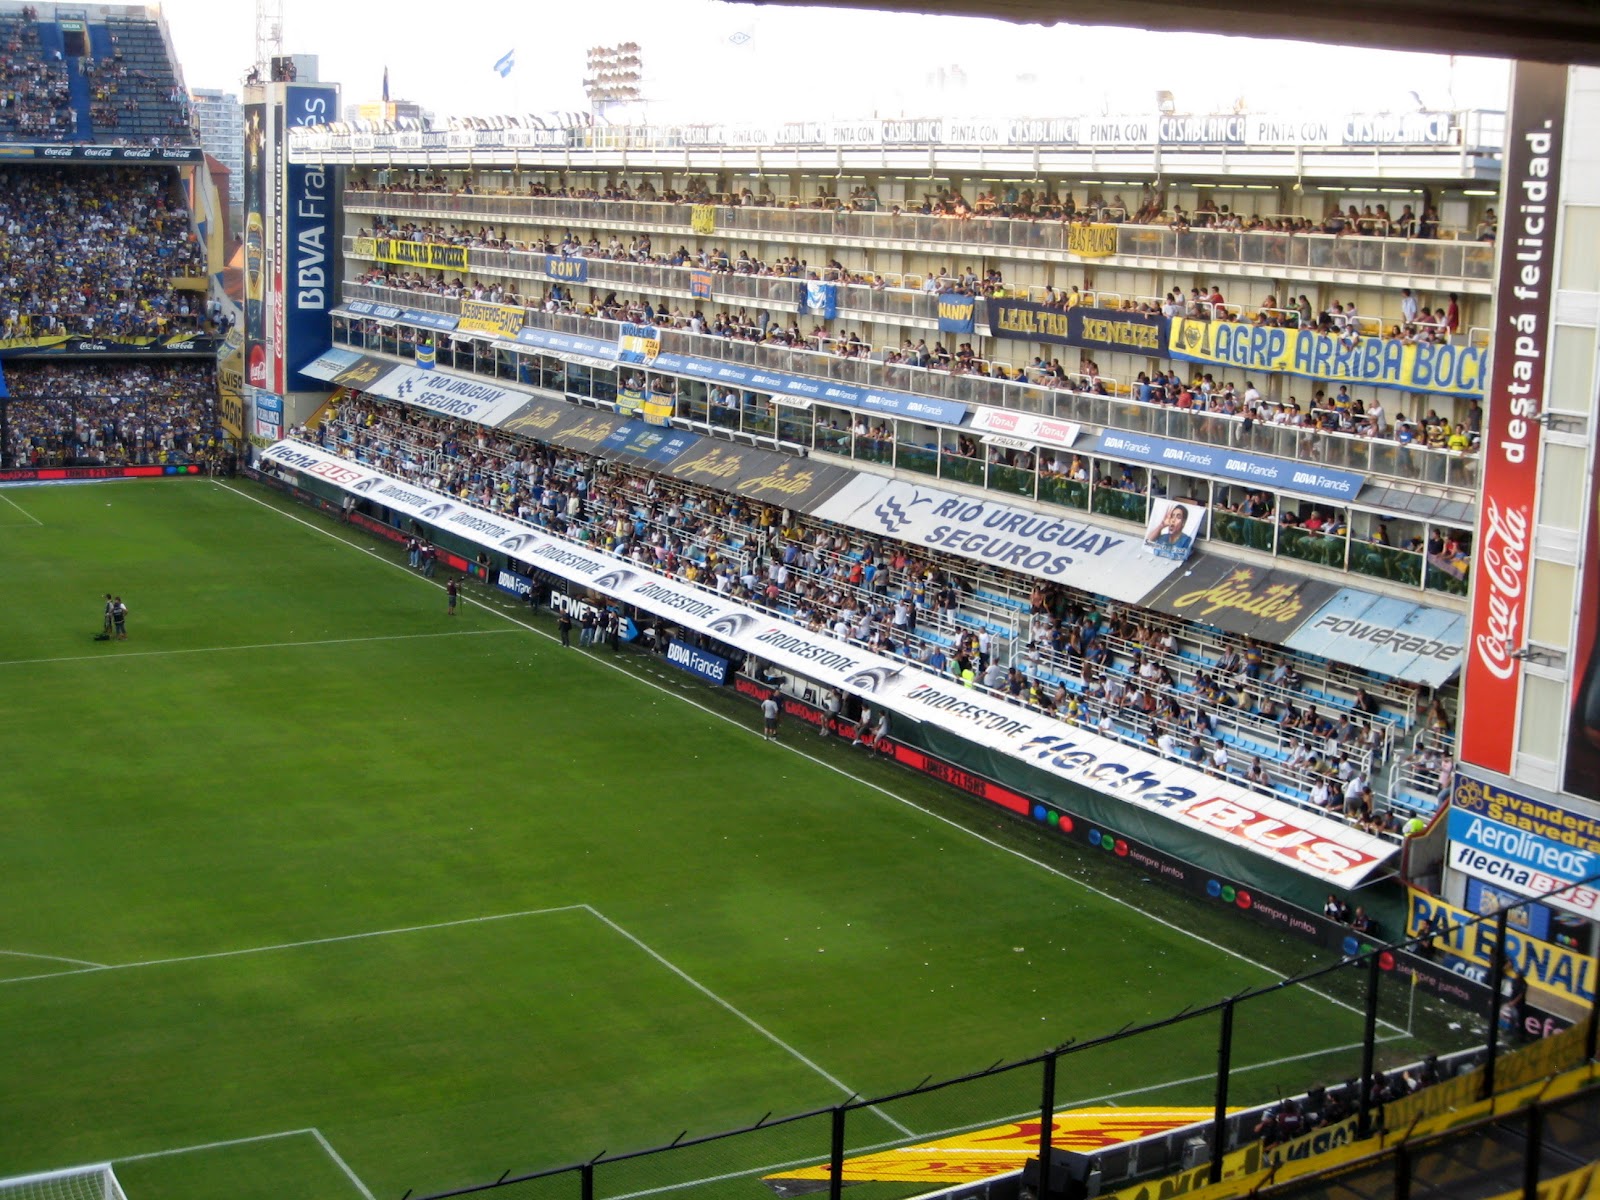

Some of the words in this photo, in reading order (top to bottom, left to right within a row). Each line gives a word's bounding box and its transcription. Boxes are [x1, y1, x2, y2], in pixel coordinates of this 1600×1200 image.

[833, 127, 855, 141] PINTA
[857, 127, 874, 141] CON
[882, 121, 942, 143] CASABLANCA
[951, 125, 977, 141] PINTA
[979, 125, 999, 141] CON
[1009, 119, 1079, 143] CASABLANCA
[1090, 124, 1121, 141] PINTA
[1124, 123, 1147, 141] CON
[1158, 117, 1246, 143] CASABLANCA
[1258, 122, 1296, 141] PINTA
[1301, 122, 1329, 141] CON
[1343, 114, 1450, 143] CASABLANCA
[296, 98, 326, 218] Fraés
[1513, 119, 1553, 300] felicidad.
[298, 225, 325, 309] BBVA
[551, 259, 581, 278] RONY
[998, 307, 1068, 338] LEALTAD
[1082, 316, 1159, 350] XENEIZE
[1215, 323, 1286, 367] AGRP
[415, 391, 479, 416] SEGUROS
[426, 375, 446, 390] RIO
[448, 380, 507, 403] URUGUAY
[865, 395, 880, 405] BBVA
[1501, 313, 1539, 464] destapá
[906, 402, 923, 413] BBVA
[922, 404, 943, 416] Francés
[993, 415, 1015, 428] TOTAL
[1040, 424, 1066, 437] TOTAL
[1104, 436, 1123, 449] BBVA
[1124, 439, 1151, 454] Francés
[265, 445, 319, 469] flecha
[312, 463, 361, 485] BUS
[1163, 447, 1183, 461] BBVA
[1183, 450, 1212, 466] Francés
[1225, 458, 1248, 472] BBVA
[1248, 462, 1278, 478] Francés
[1292, 471, 1317, 486] BBVA
[1316, 475, 1350, 492] Francés
[931, 498, 984, 522] RIO
[983, 509, 1125, 557] URUGUAY
[532, 543, 605, 577] BRIDGESTONE
[924, 525, 1074, 576] SEGUROS
[498, 571, 515, 590] BBVA
[1477, 495, 1528, 680] Coca-Cola
[633, 581, 720, 620] BRIDGESTONE
[667, 642, 689, 667] BBVA
[689, 652, 724, 681] Francés
[755, 627, 863, 674] BRIDGESTONE
[907, 684, 1032, 739] BRIDGESTONE
[1017, 734, 1198, 810] flecha
[1183, 797, 1378, 877] BUS
[1465, 818, 1588, 878] Aerolíneas
[1129, 849, 1160, 869] siempre
[1159, 862, 1184, 880] juntos
[1458, 848, 1530, 886] flecha
[1530, 873, 1599, 909] BUS
[1253, 901, 1288, 923] siempre
[1288, 915, 1317, 935] juntos
[1413, 895, 1596, 1002] PATERNAL
